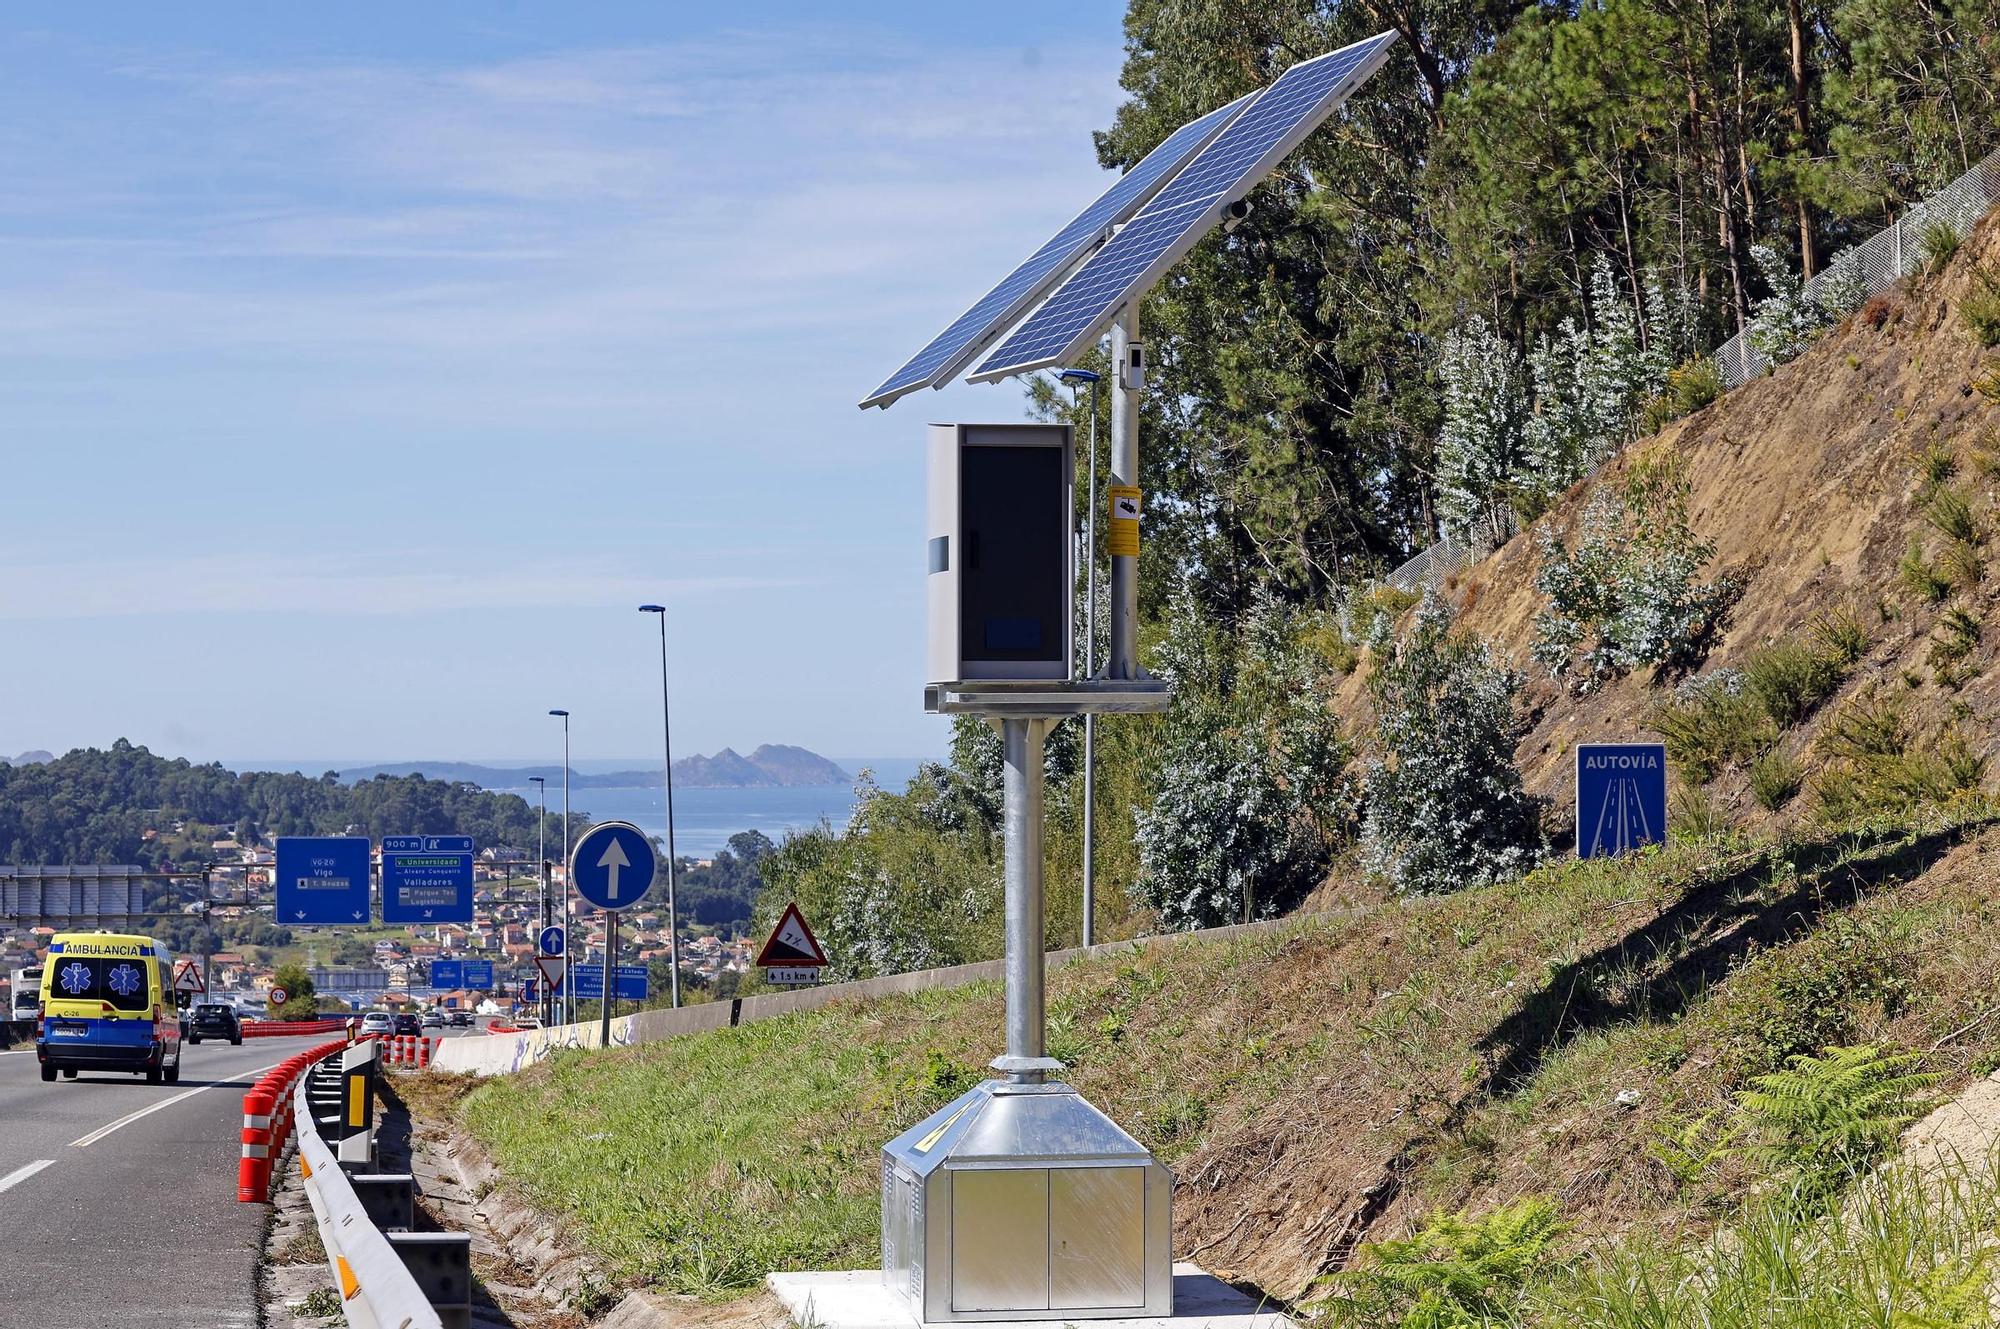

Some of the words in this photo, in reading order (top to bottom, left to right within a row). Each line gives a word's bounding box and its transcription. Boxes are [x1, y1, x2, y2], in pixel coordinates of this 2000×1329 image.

[1585, 752, 1658, 769] AUTOVÍA
[386, 840, 406, 848] 900
[463, 840, 469, 848] 8
[314, 868, 333, 878] Vigo
[404, 878, 453, 886] Valladares
[65, 944, 138, 956] AMBULANCIA
[794, 971, 807, 980] km
[273, 992, 285, 1000] 70
[63, 1010, 80, 1018] C-26
